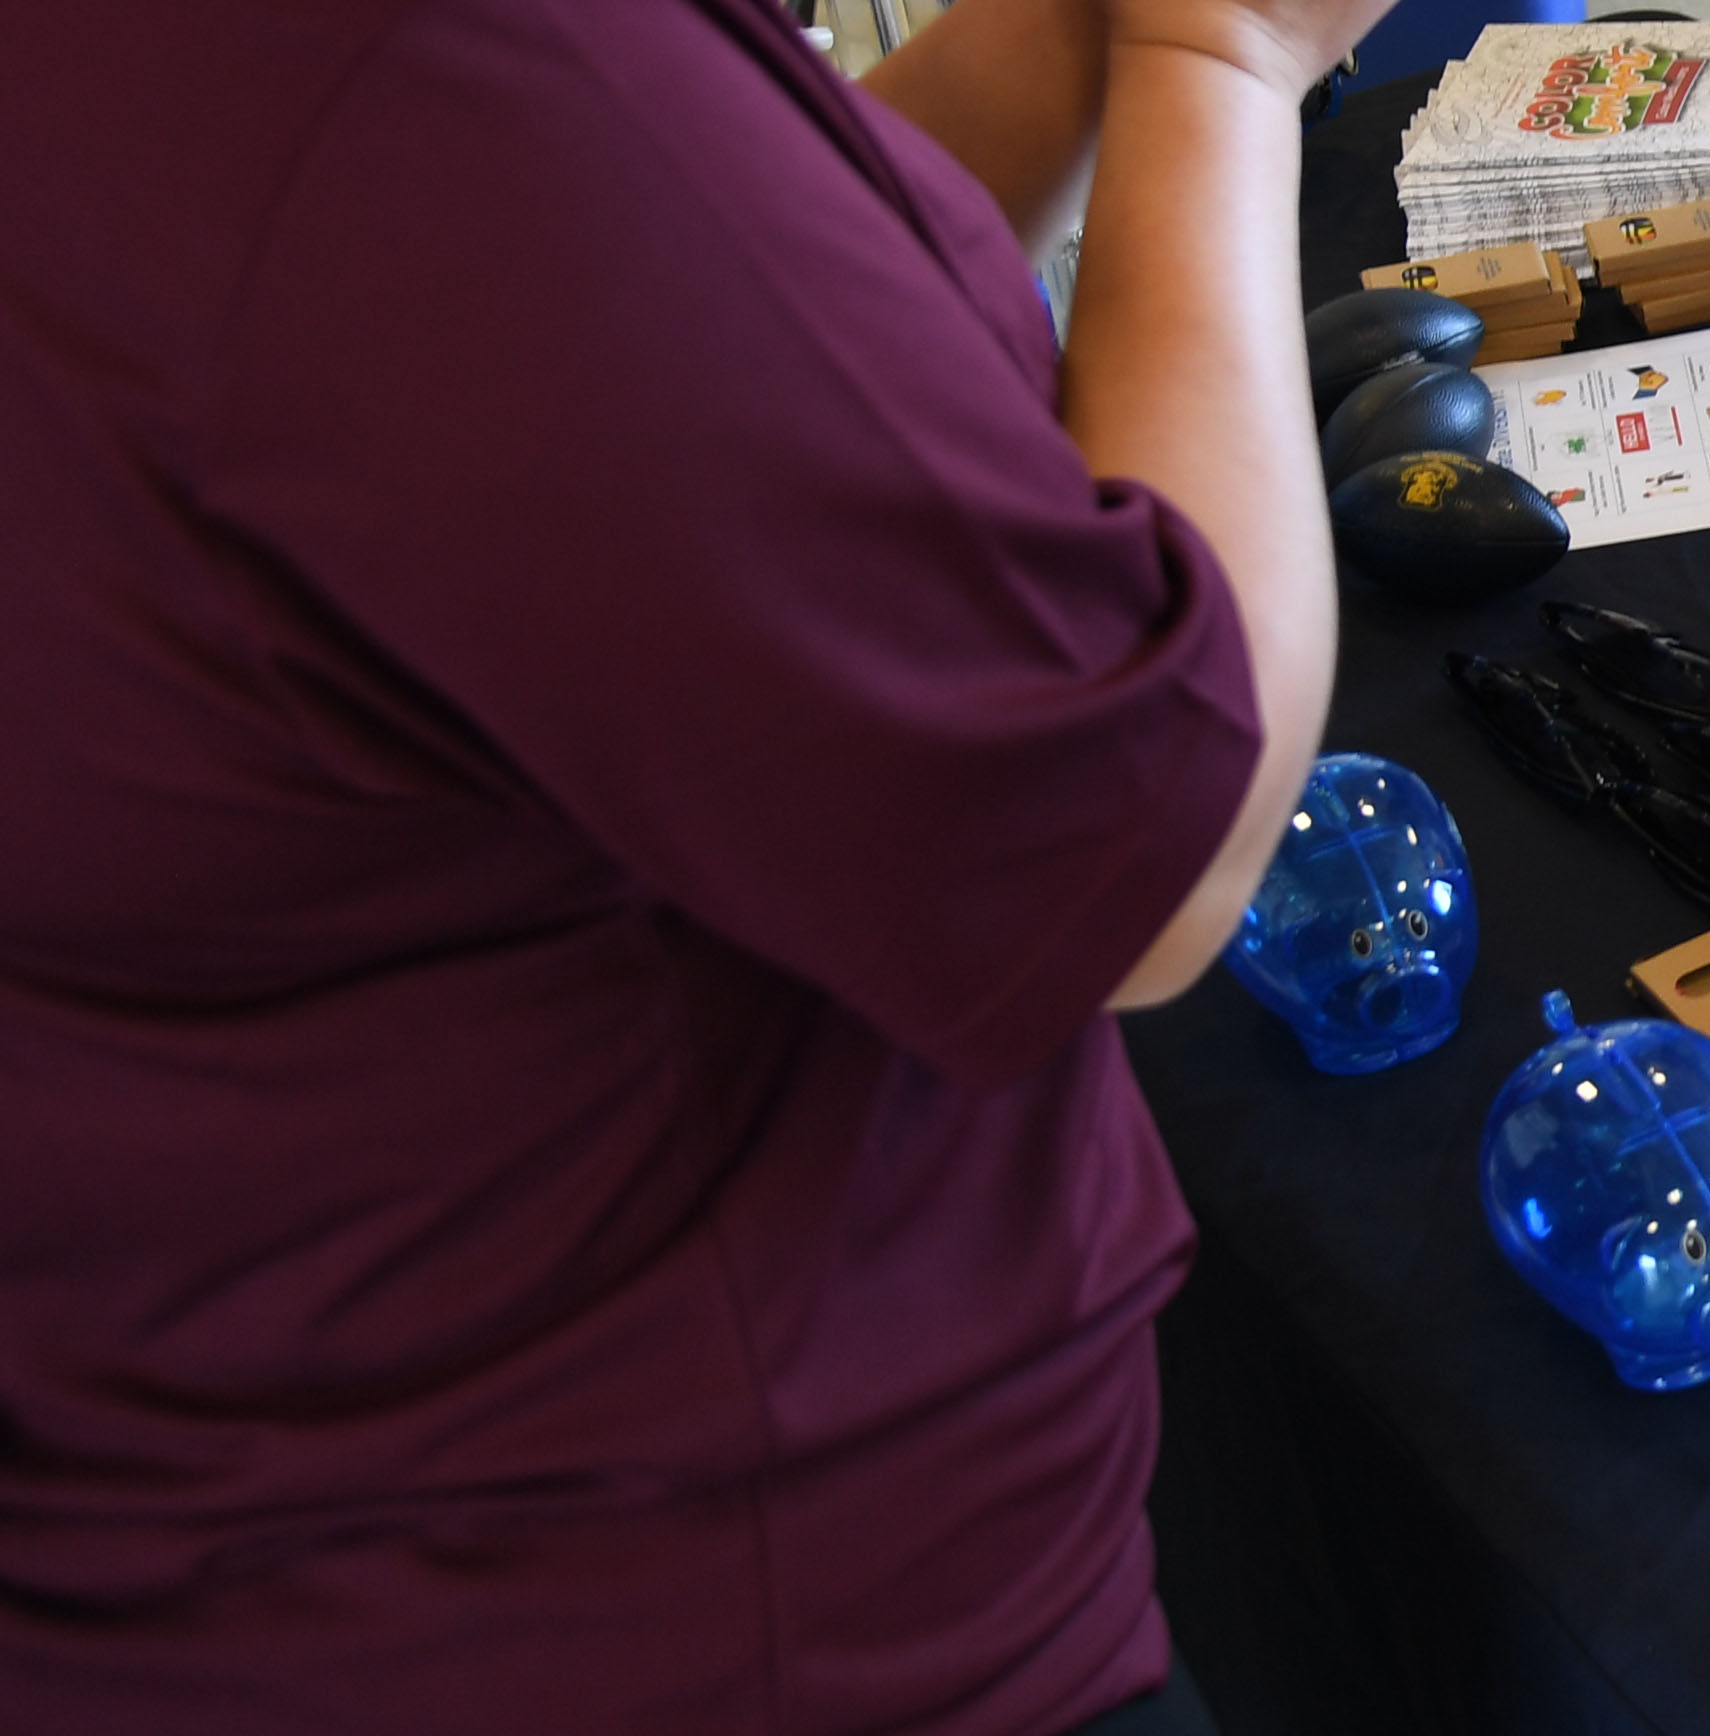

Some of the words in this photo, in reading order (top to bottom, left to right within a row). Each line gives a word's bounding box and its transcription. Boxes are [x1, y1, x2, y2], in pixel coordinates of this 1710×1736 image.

[1517, 55, 1596, 132] COLOR
[1548, 43, 1666, 140] Comfort
[1619, 416, 1642, 449] HELLO
